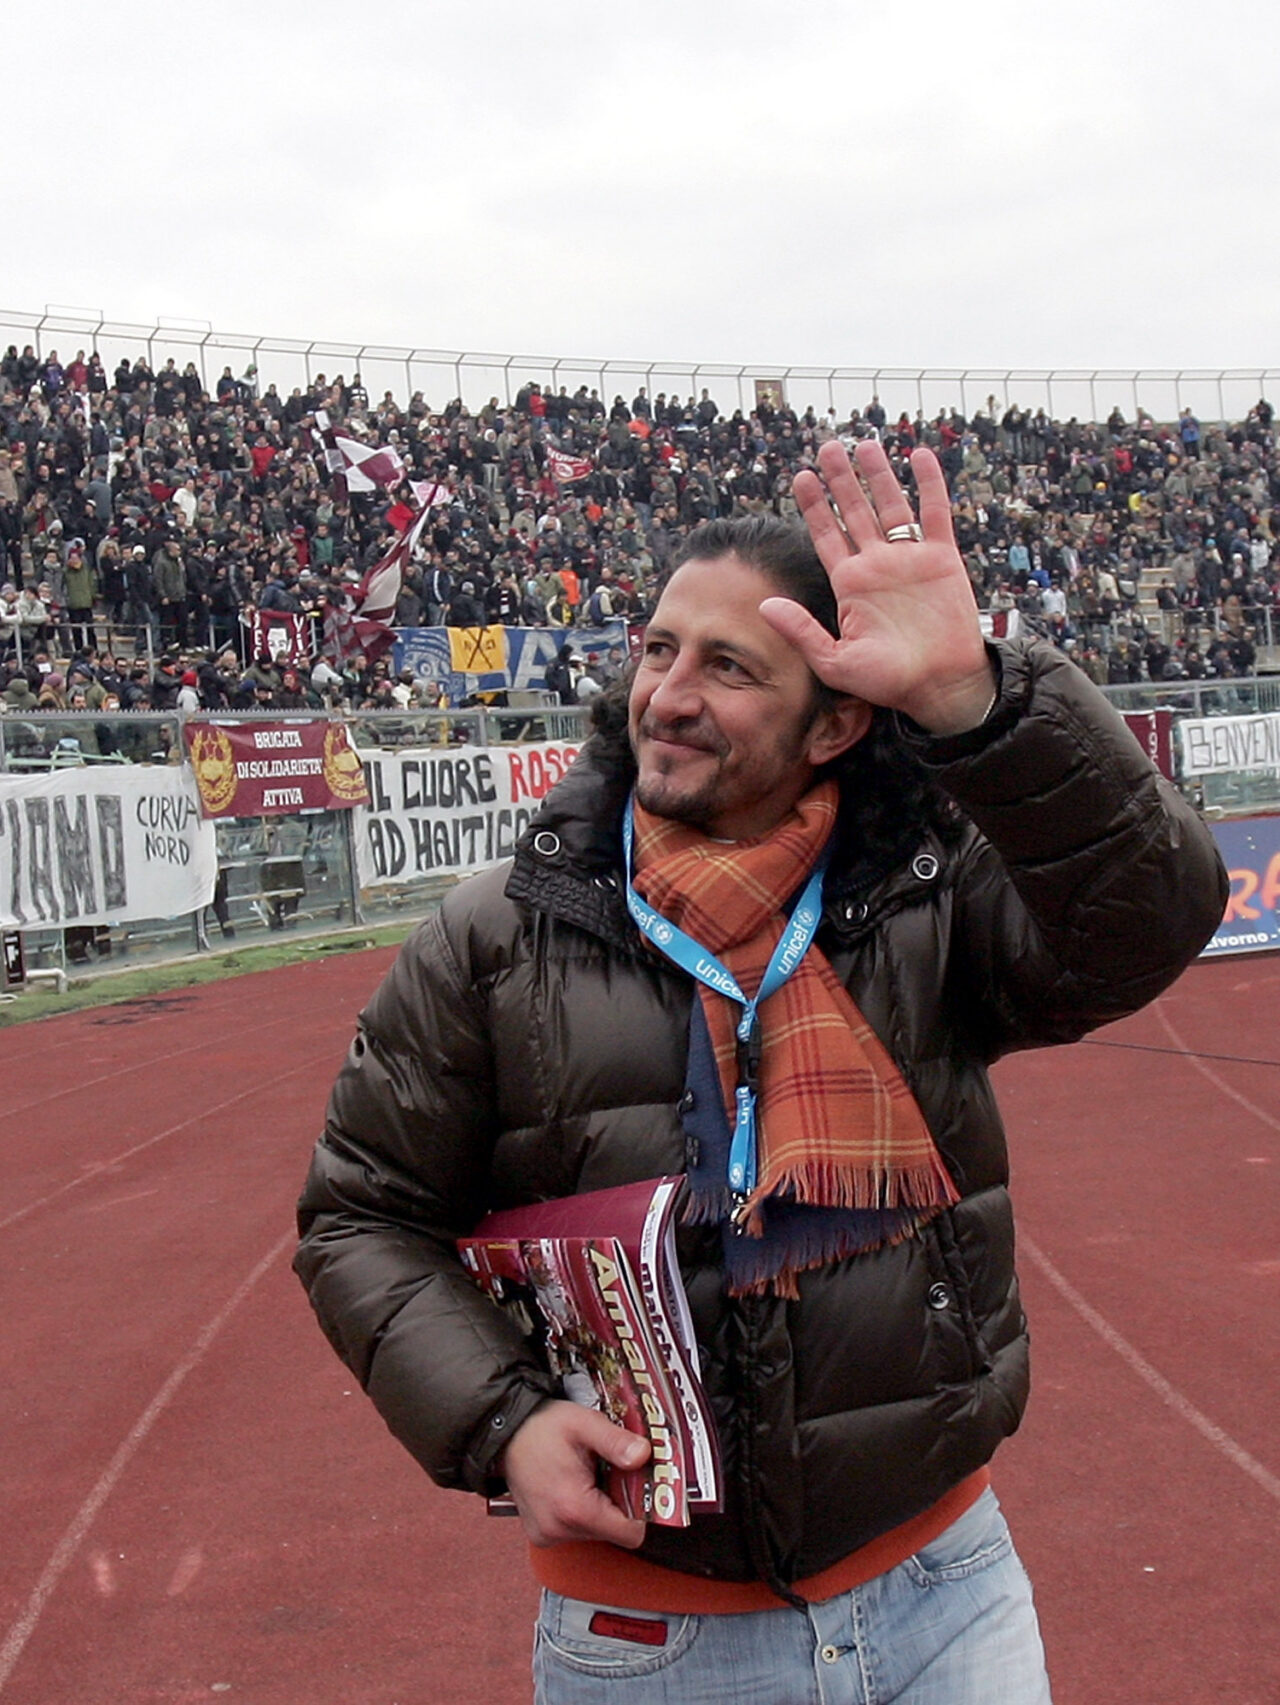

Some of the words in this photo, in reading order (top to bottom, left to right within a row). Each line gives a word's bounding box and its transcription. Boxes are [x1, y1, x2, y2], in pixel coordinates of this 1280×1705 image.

[254, 731, 302, 749] BRIGATA
[263, 787, 304, 807] ATTIVA
[363, 761, 391, 813] IL
[401, 754, 497, 810] CUORE
[136, 796, 201, 831] CURVA
[144, 832, 190, 866] NORD
[369, 818, 407, 877] AD
[777, 922, 811, 976] unicef
[589, 1247, 676, 1520] Amaranto
